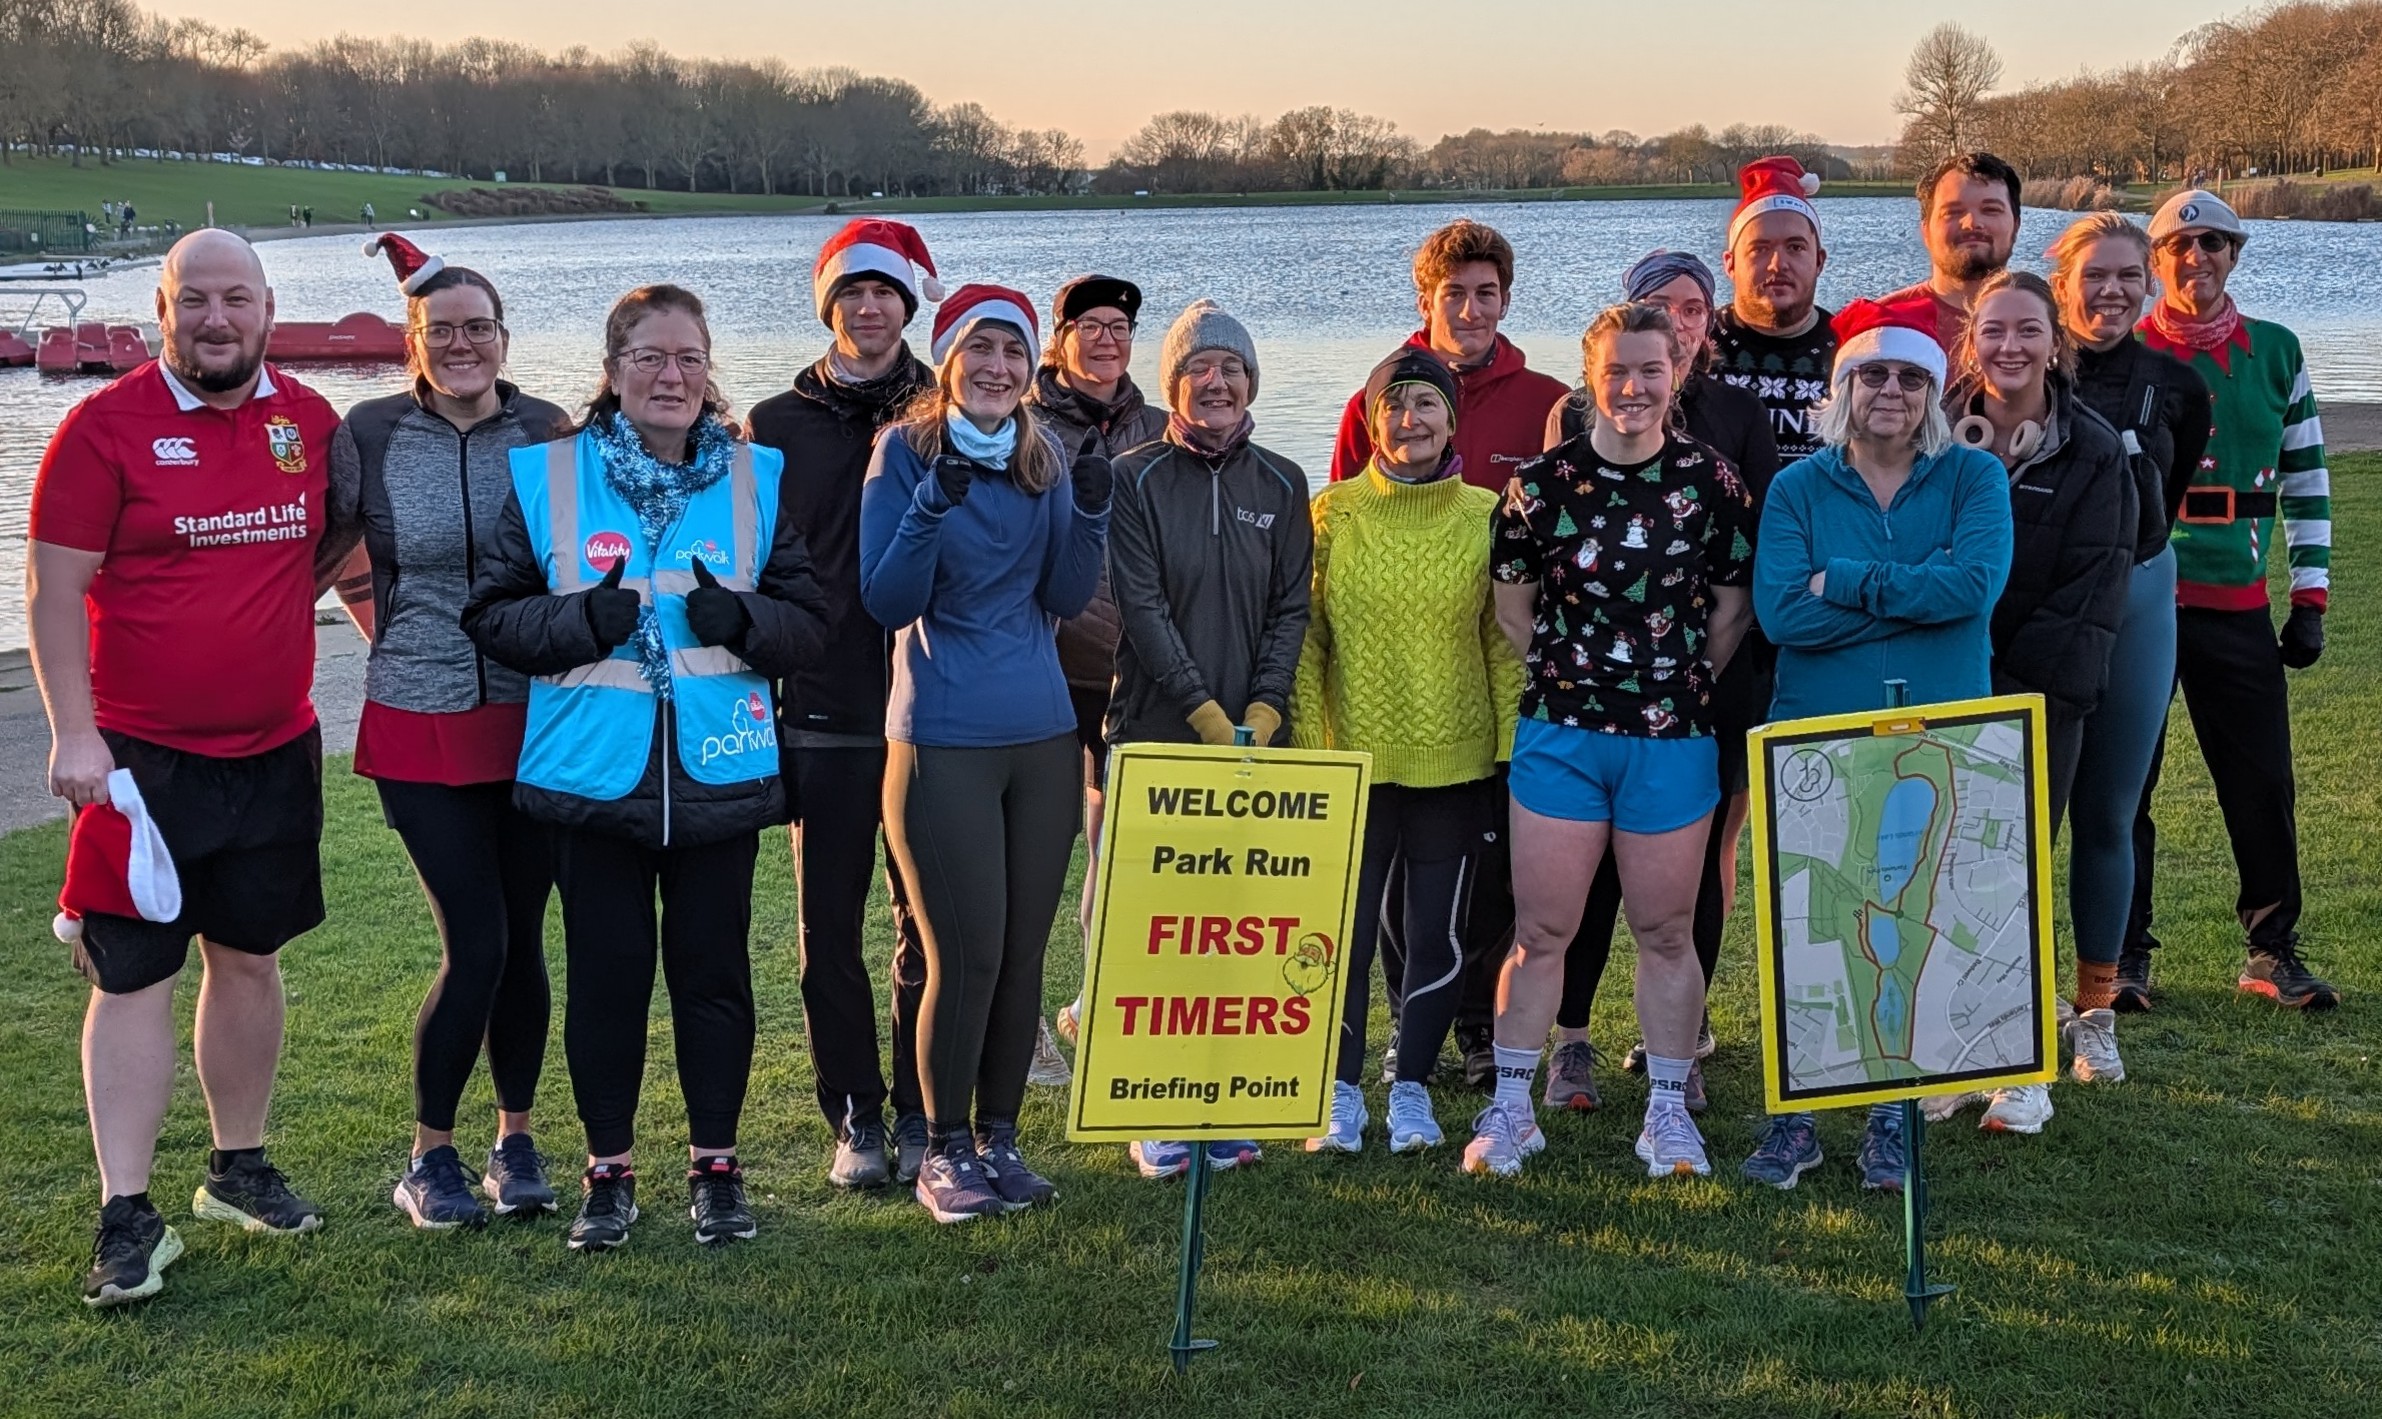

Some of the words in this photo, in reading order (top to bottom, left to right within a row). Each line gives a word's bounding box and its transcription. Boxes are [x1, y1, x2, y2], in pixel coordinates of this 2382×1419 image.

[174, 507, 266, 535] Standard
[270, 503, 307, 524] Life
[1237, 506, 1255, 524] tcs
[189, 523, 307, 548] Investments
[586, 540, 631, 559] Vitality
[675, 546, 730, 565] pakwalk
[1148, 786, 1330, 821] WELCOME
[1152, 845, 1234, 876] Park
[1245, 848, 1311, 877] Run
[1147, 915, 1300, 956] FIRST
[1115, 996, 1311, 1036] TIMERS
[1110, 1077, 1220, 1104] Briefing
[1229, 1075, 1300, 1098] Point
